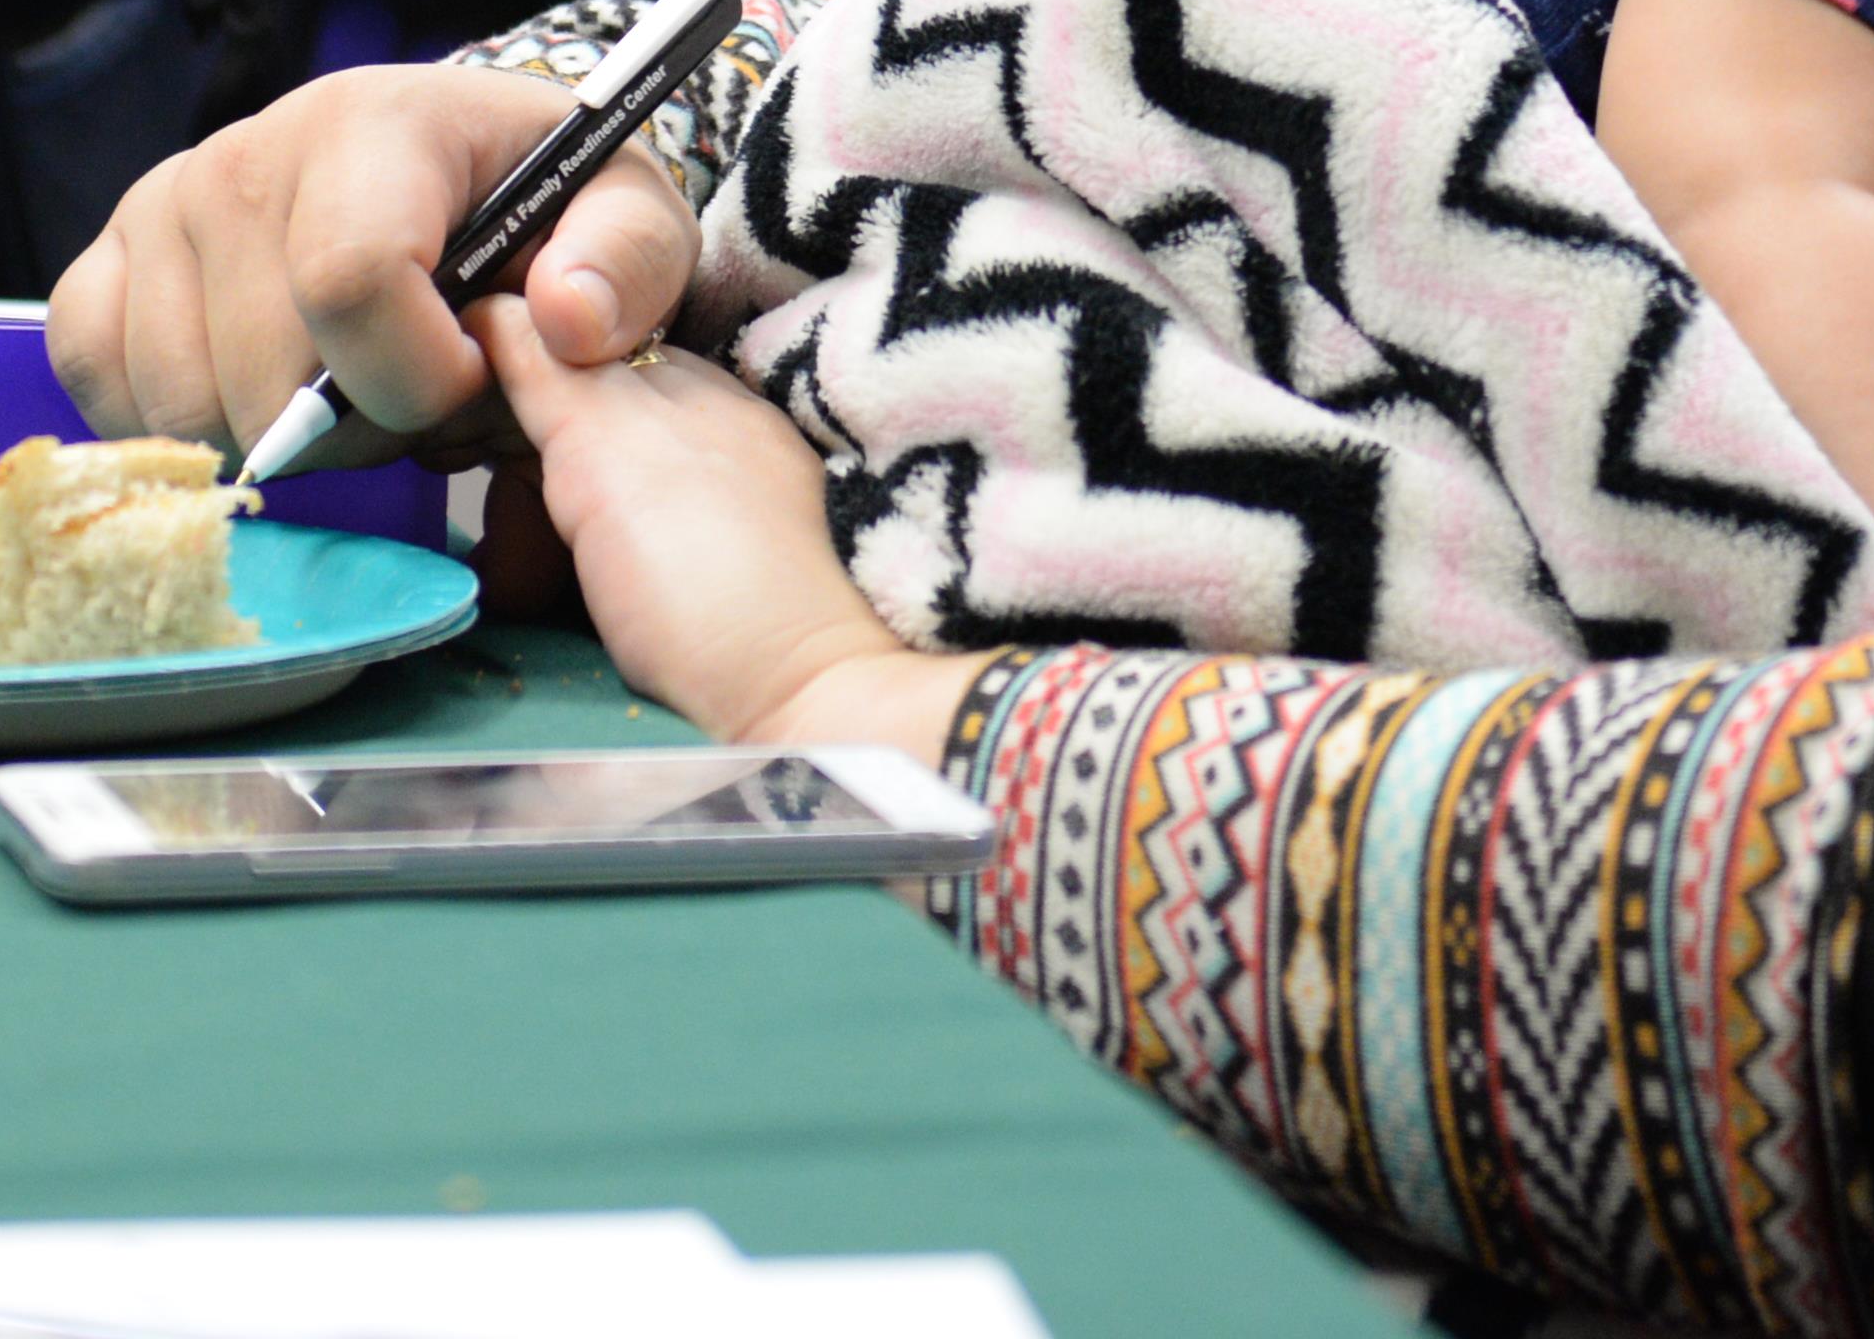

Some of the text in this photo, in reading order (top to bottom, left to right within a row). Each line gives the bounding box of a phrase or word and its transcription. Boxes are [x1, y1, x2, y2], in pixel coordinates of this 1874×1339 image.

[457, 63, 668, 282] Military & Family Readiness Center
